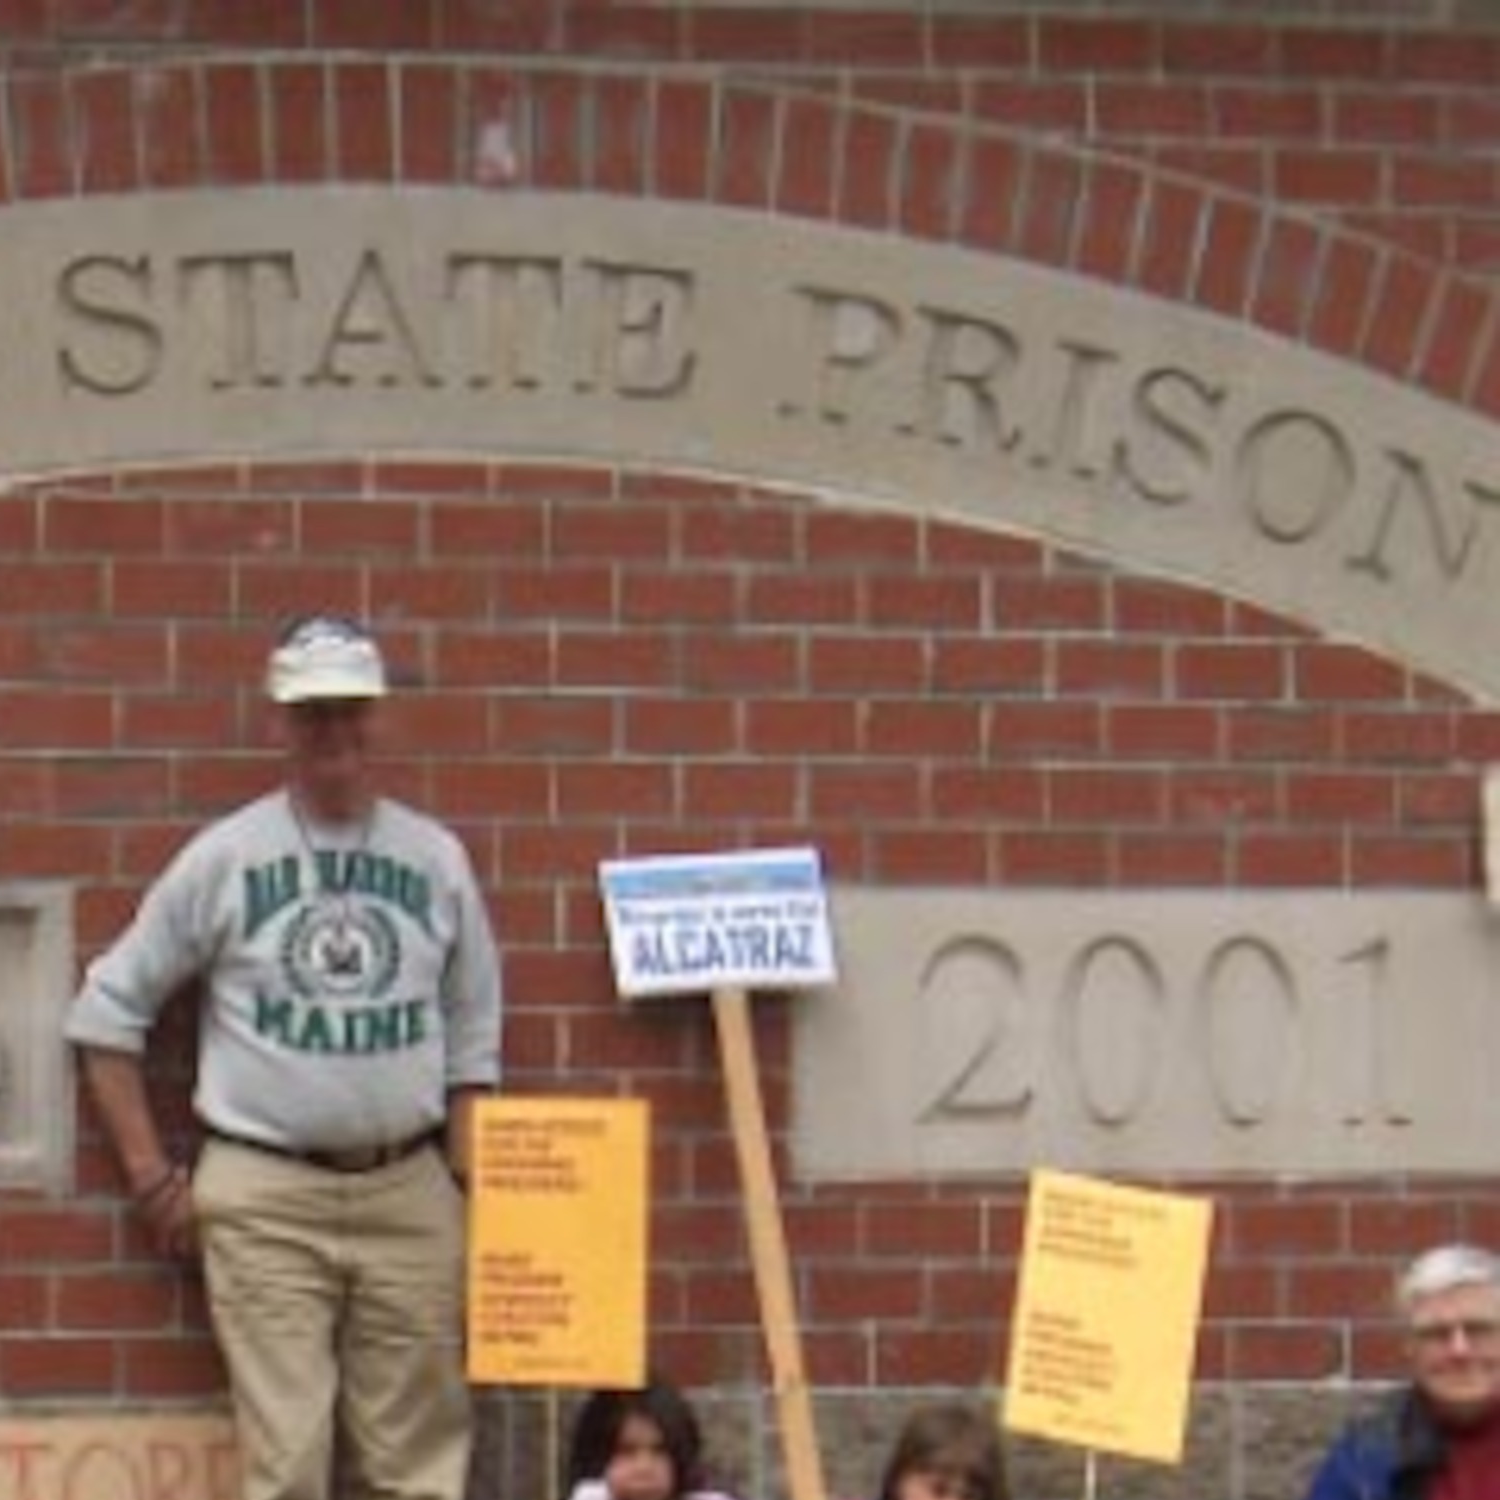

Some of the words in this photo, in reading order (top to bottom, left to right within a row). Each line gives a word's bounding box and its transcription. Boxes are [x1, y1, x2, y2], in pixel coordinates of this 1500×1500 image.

[55, 250, 697, 397] STATE
[776, 284, 1500, 582] PRISON
[632, 924, 816, 976] ALCATRAZ
[253, 990, 426, 1053] MAINE
[913, 932, 1414, 1128] 2001
